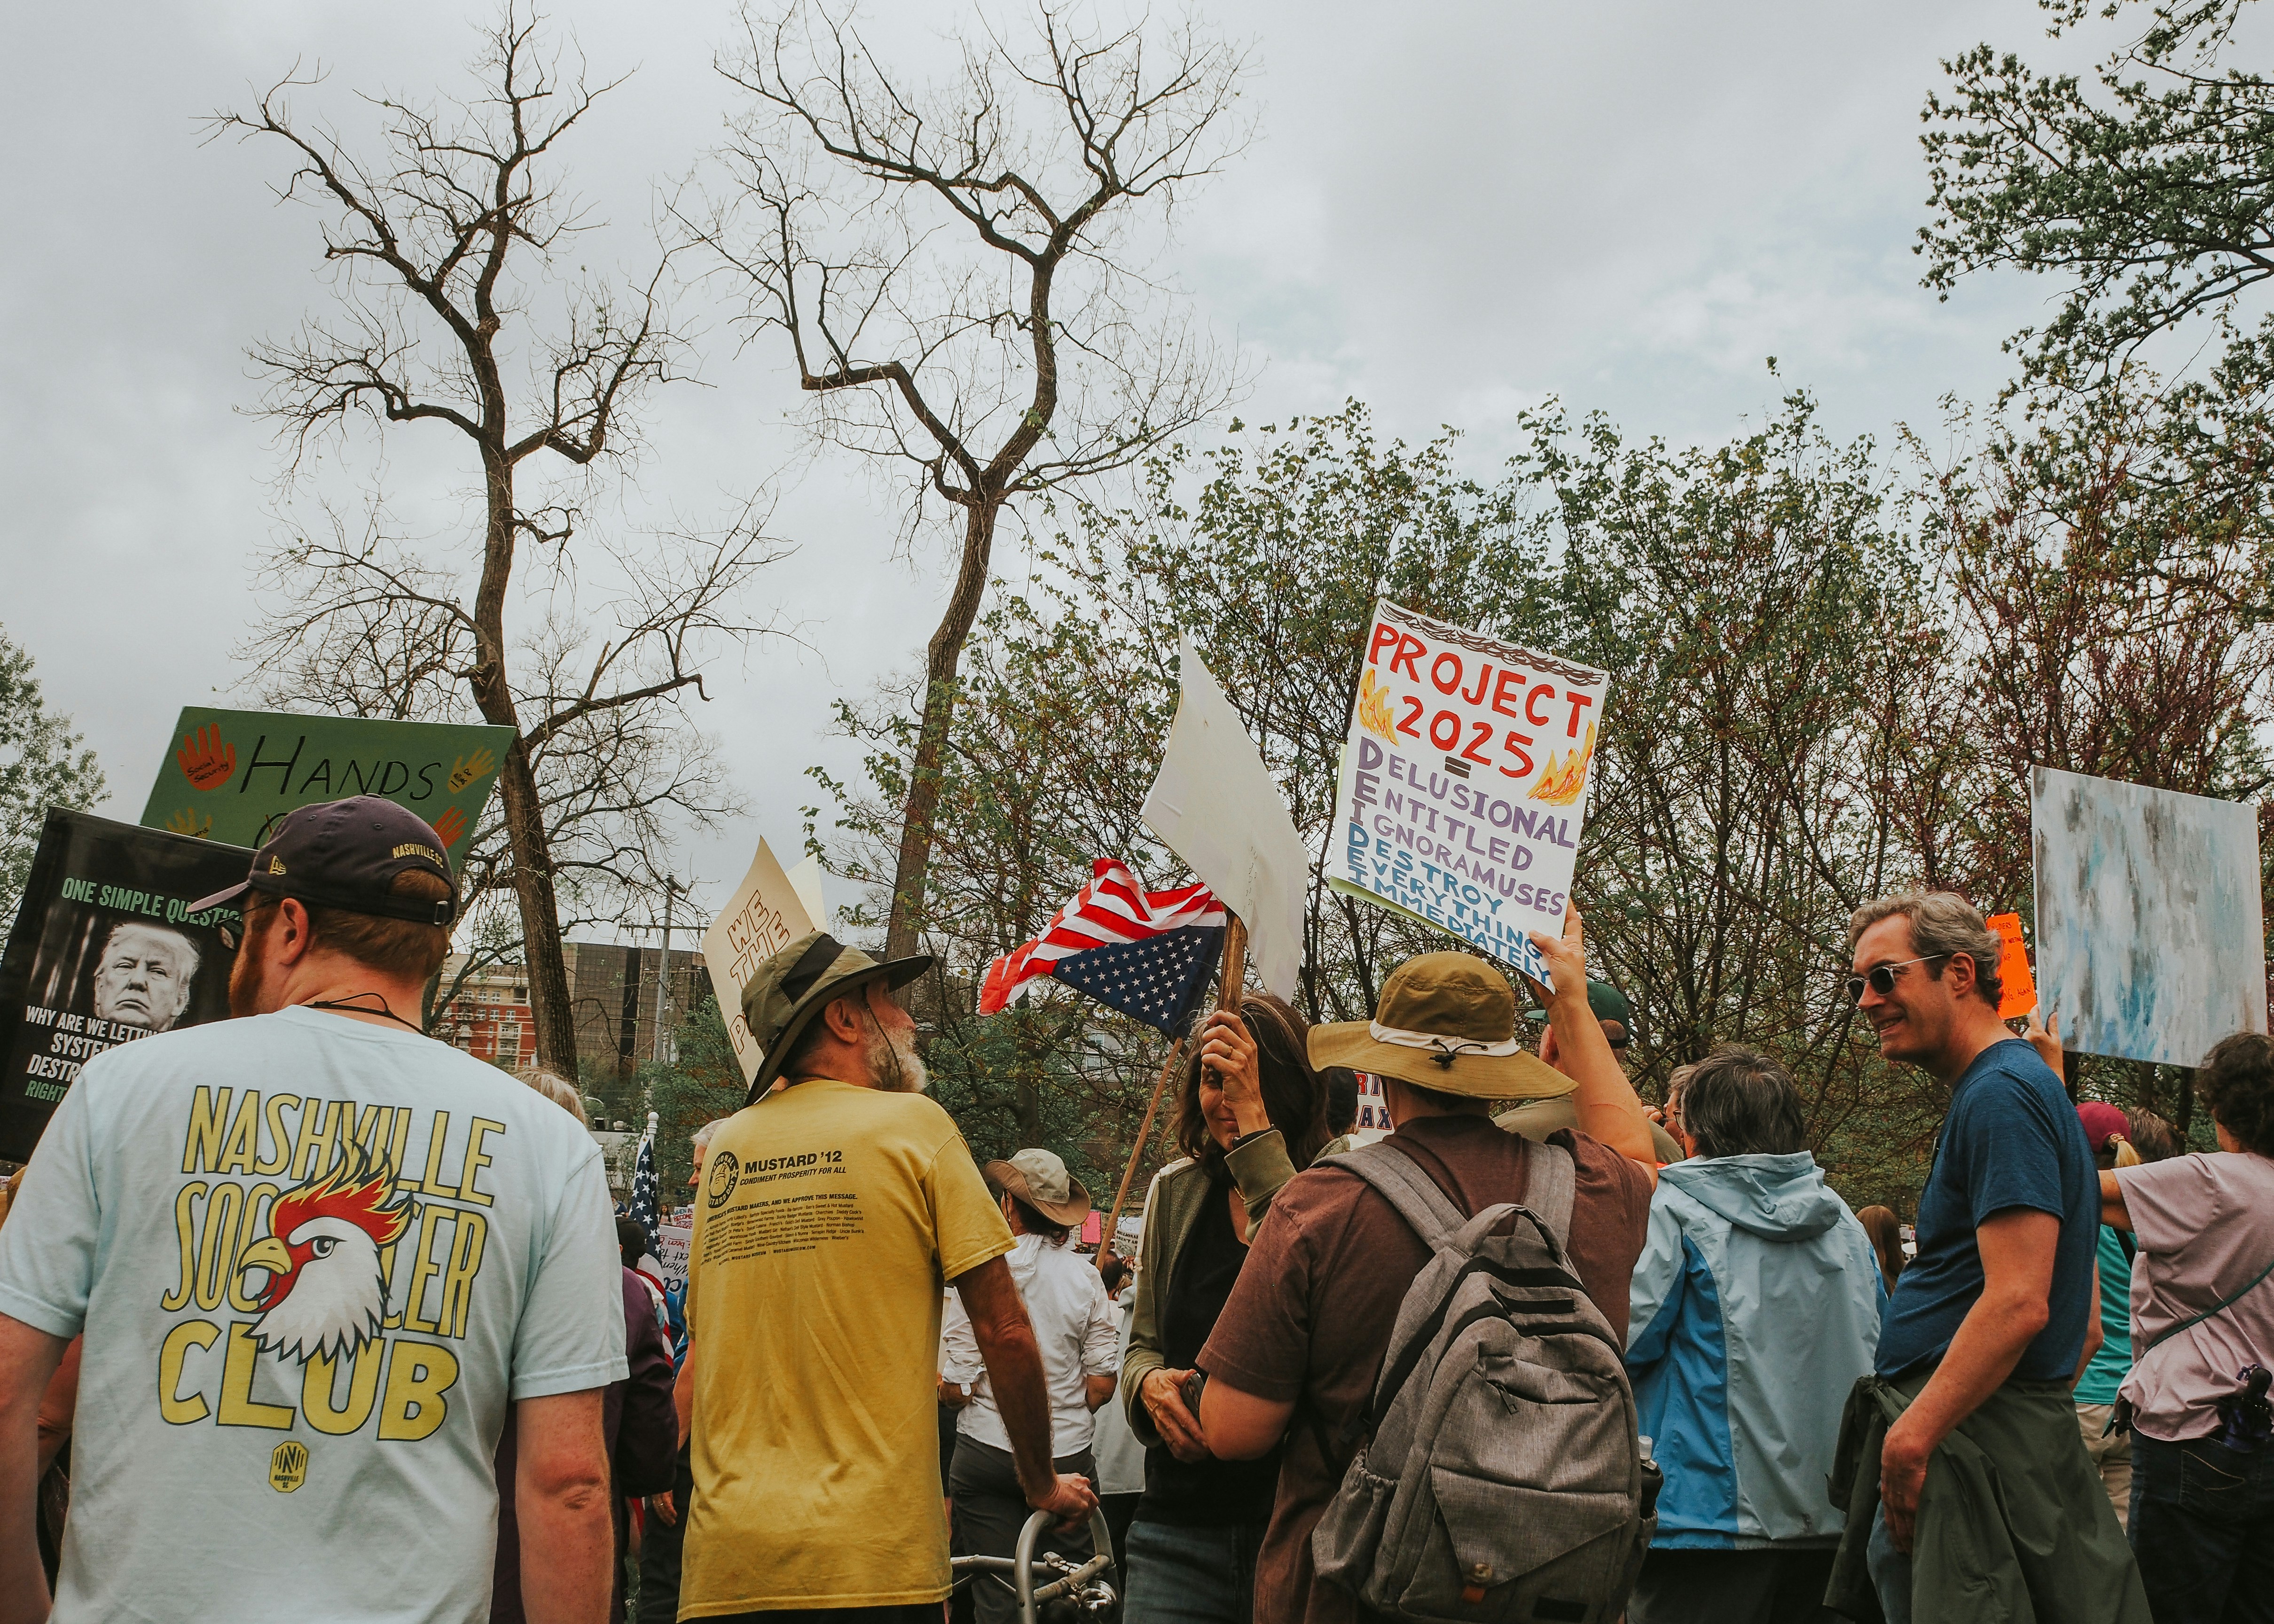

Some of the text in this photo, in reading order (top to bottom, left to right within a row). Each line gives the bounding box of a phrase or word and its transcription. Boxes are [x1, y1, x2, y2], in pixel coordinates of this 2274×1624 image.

[1368, 622, 1592, 738] PROJECT
[188, 757, 214, 776] Social
[194, 763, 229, 783] Security
[240, 735, 441, 799] HANDS
[1396, 696, 1534, 779] 2025
[1354, 775, 1533, 871] ENTITLED
[1357, 736, 1576, 849] DELUSIONAL
[392, 843, 435, 861] NASHVILLE
[1347, 822, 1503, 915] DESTROY
[1349, 799, 1566, 916] IGNORAMUSES
[62, 877, 97, 903] ONE
[99, 885, 164, 917] SIMPLE
[727, 889, 769, 953] WE
[1347, 846, 1542, 960] EVERYTHING
[1348, 865, 1551, 986] IMMEDIATELY
[730, 910, 790, 989] THE
[26, 1005, 57, 1026] WHY
[56, 1013, 85, 1032] ARE
[86, 1018, 109, 1037] WE
[25, 1080, 67, 1102] RIGHT
[182, 1085, 506, 1207] NASHVILLE
[740, 1174, 777, 1186] CONDIMENT
[778, 1168, 818, 1179] PROSPERITY
[745, 1150, 842, 1174] MUSTARD '12
[727, 1205, 748, 1214] MUSTARD
[749, 1201, 770, 1209] MAKERS,
[792, 1195, 814, 1203] APPROVE
[160, 1180, 489, 1340] SOCER
[668, 1241, 685, 1250] been
[158, 1319, 459, 1441] CLUB
